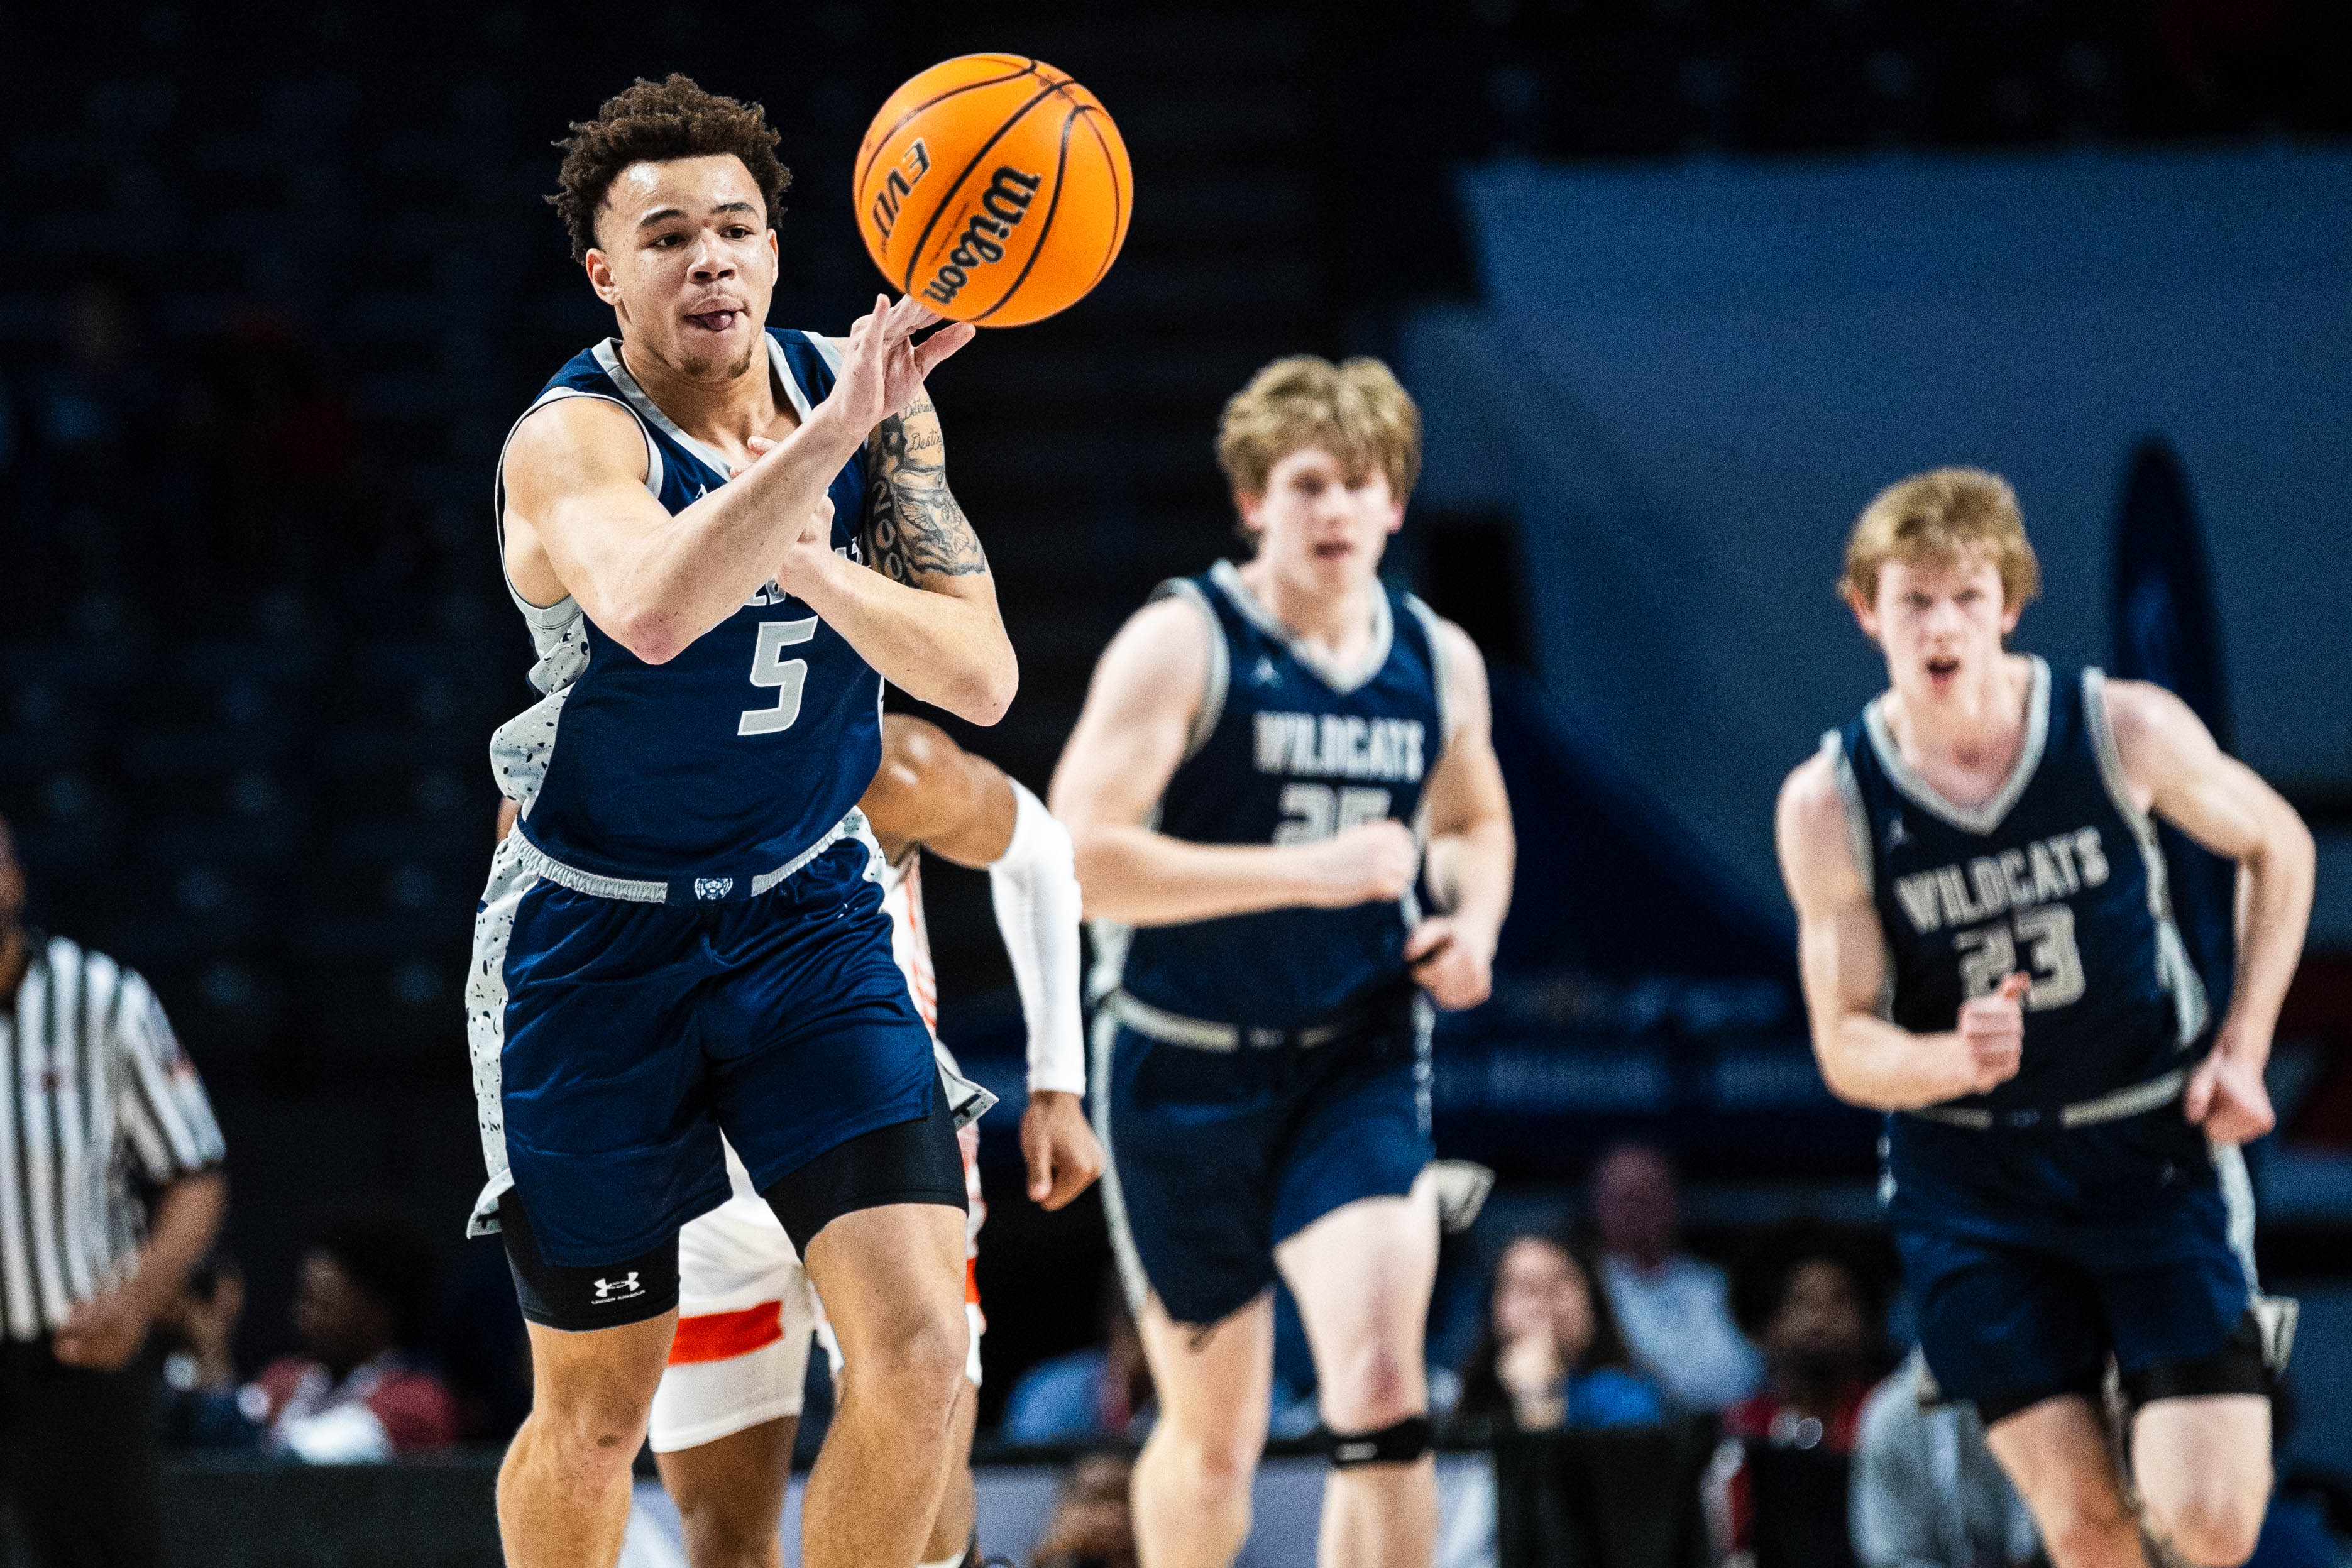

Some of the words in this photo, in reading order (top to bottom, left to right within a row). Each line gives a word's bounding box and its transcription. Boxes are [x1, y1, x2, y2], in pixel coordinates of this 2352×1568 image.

[922, 165, 1042, 305] Wilson
[737, 615, 818, 736] 5
[1254, 710, 1426, 783] WILDCATS
[1893, 826, 2110, 935] WILDCATS
[1952, 902, 2086, 1013] 23
